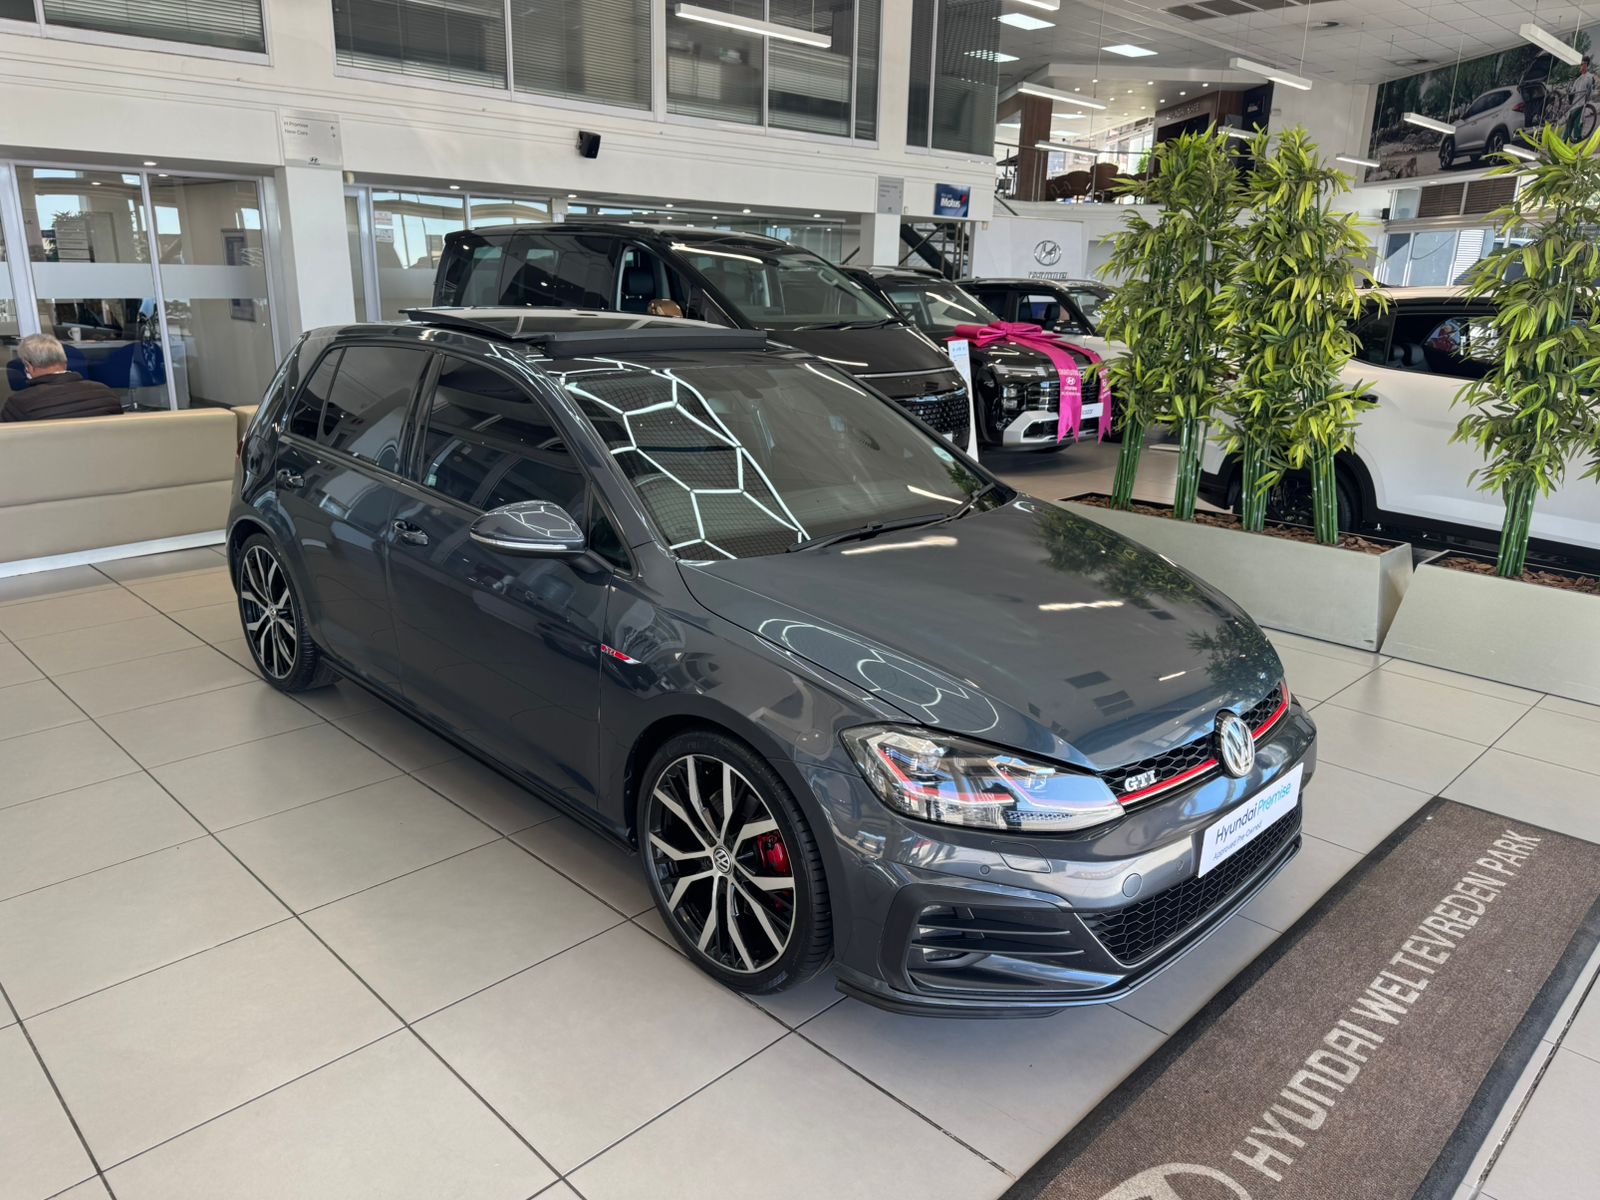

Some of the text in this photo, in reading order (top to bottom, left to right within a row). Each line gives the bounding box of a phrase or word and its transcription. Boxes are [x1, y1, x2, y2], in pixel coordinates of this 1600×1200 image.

[1124, 770, 1157, 792] GTI
[1215, 783, 1292, 844] Hyundai Promise
[1231, 829, 1542, 1182] HYUNDAI WELTEVREDEN PARK
